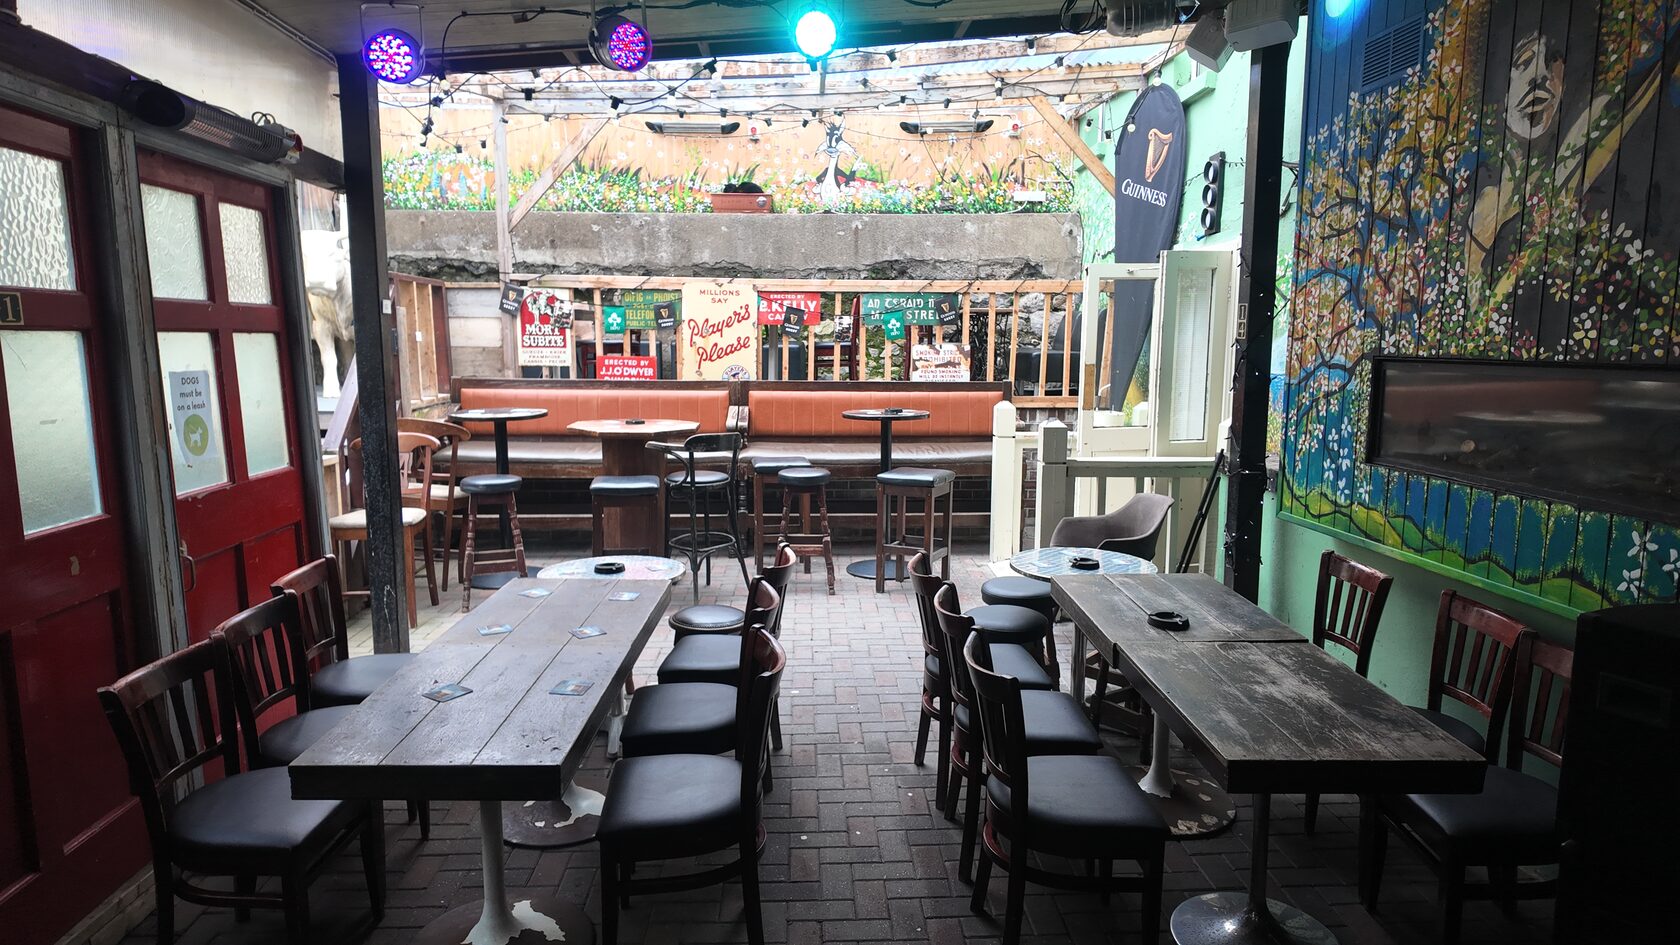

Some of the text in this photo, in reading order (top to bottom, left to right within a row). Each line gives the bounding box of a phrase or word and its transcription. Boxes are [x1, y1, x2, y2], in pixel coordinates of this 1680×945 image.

[1121, 178, 1168, 207] GUINNESS
[4, 296, 17, 321] 1
[687, 304, 751, 348] Player's
[522, 335, 565, 347] SUBITE
[697, 336, 751, 370] Please
[181, 376, 199, 385] DOGS
[179, 388, 202, 398] must be
[191, 401, 206, 409] leash
